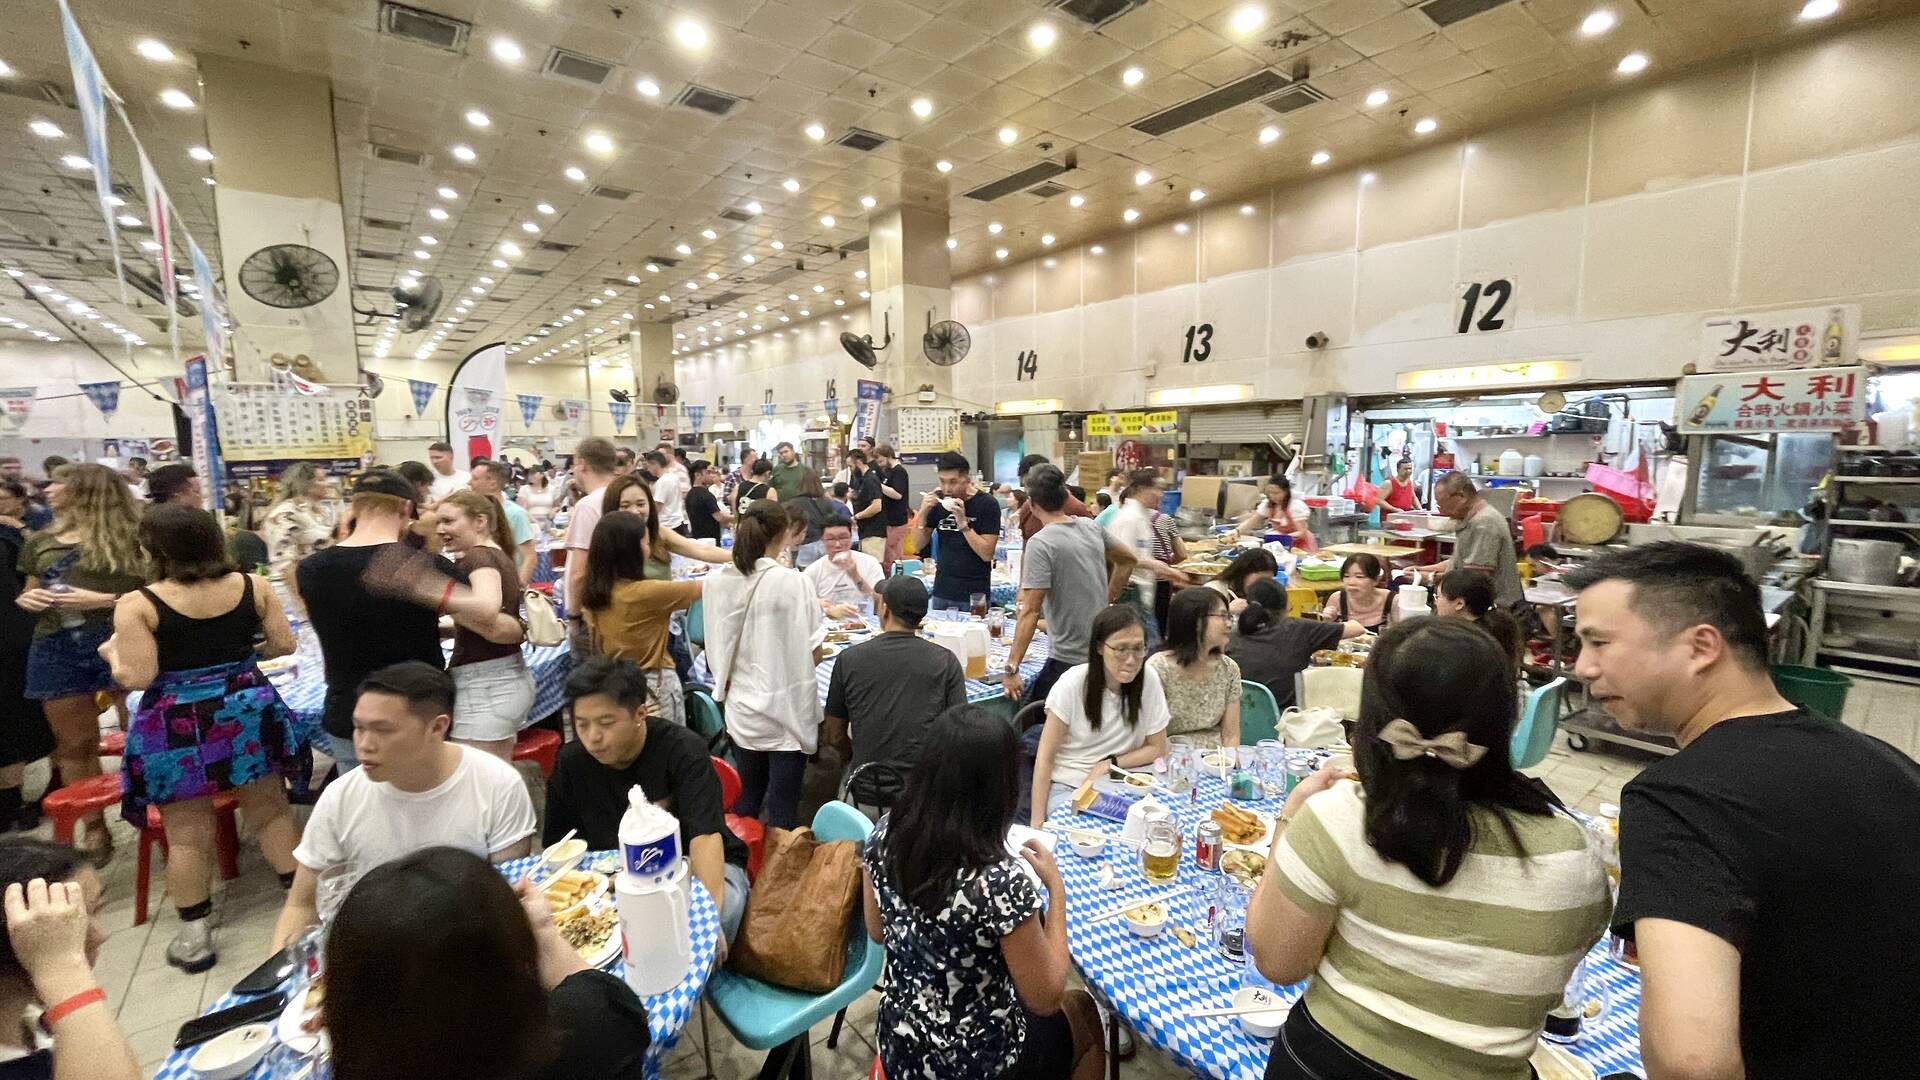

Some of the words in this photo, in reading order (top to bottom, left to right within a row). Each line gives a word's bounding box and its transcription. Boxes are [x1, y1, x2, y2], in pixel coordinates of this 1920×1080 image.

[1458, 279, 1512, 334] 12
[1183, 323, 1214, 363] 13
[1720, 320, 1790, 357] 大利
[1017, 350, 1038, 382] 14
[826, 379, 837, 400] 16
[1740, 373, 1855, 401] 大利
